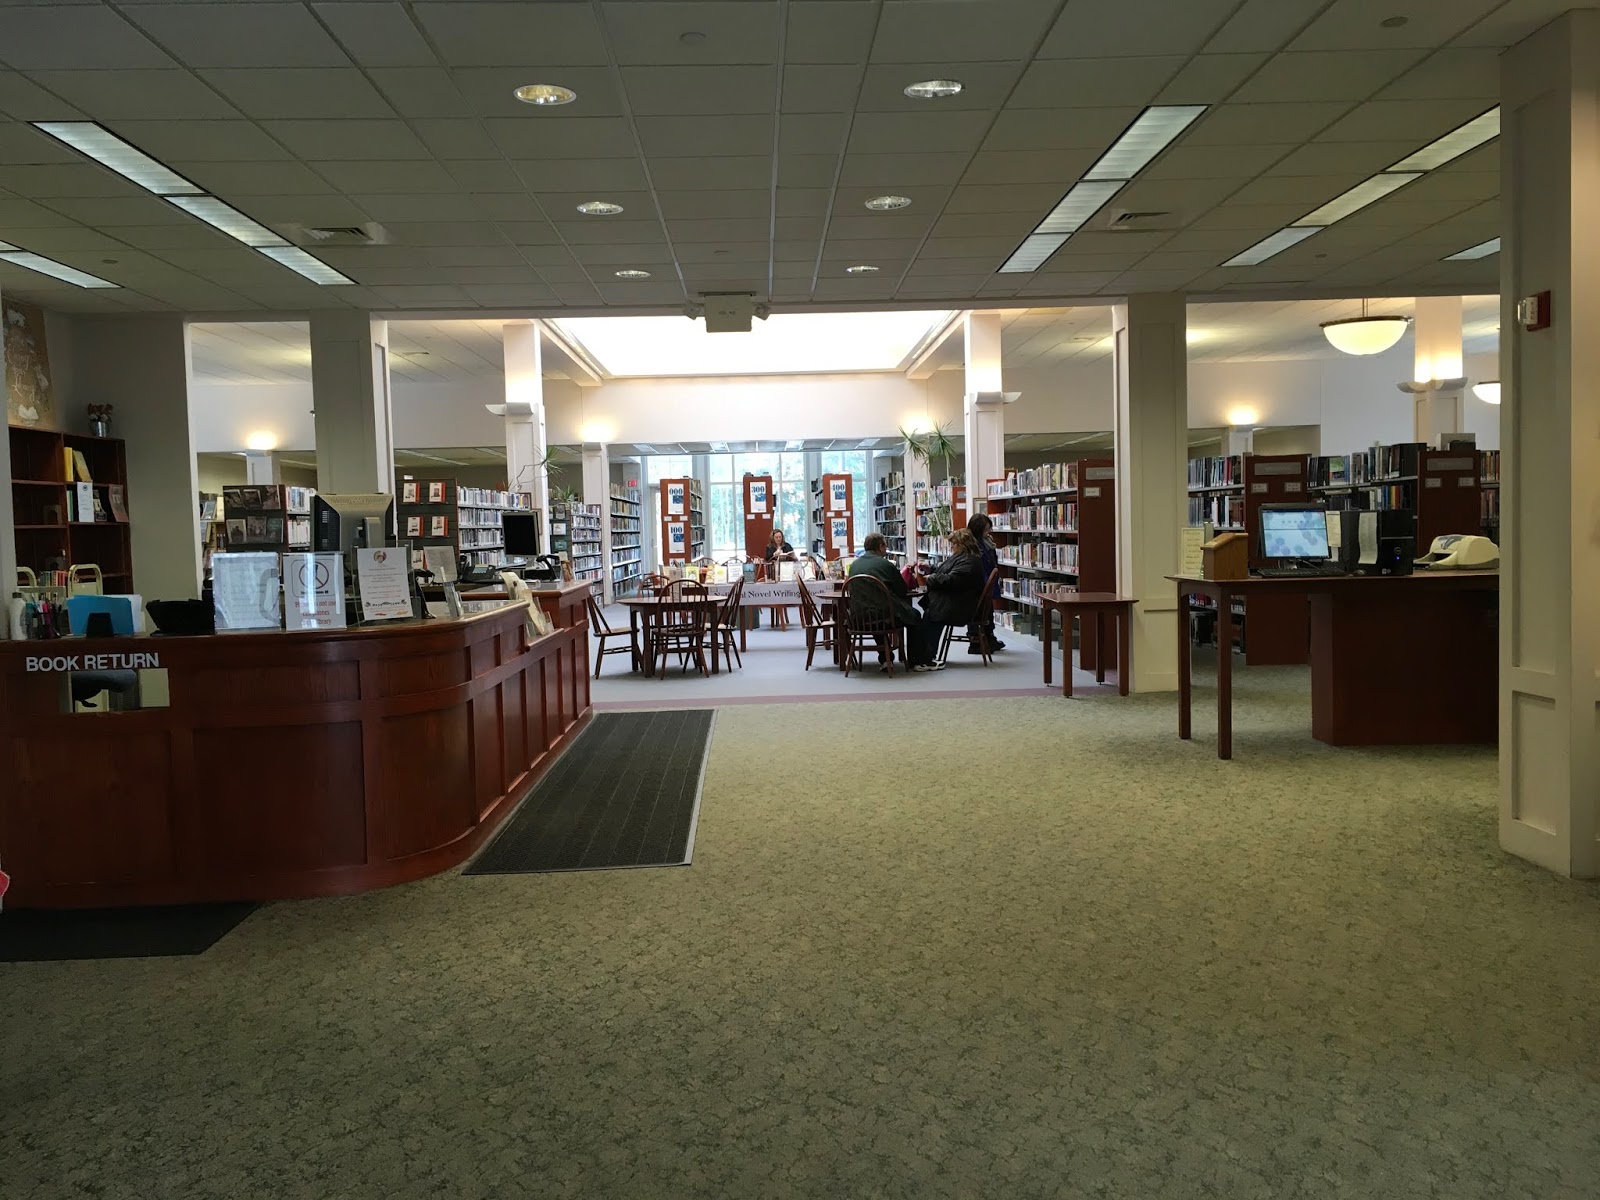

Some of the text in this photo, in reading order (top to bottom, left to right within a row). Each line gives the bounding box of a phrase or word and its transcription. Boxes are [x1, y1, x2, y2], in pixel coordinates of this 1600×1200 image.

[751, 485, 765, 493] 300
[831, 483, 845, 491] 400
[912, 481, 926, 489] 600
[669, 488, 683, 496] 000
[832, 521, 846, 529] 500
[670, 526, 683, 534] 100
[748, 590, 772, 599] Novel
[774, 588, 801, 598] Writing
[26, 653, 160, 672] BOOK RETURN
